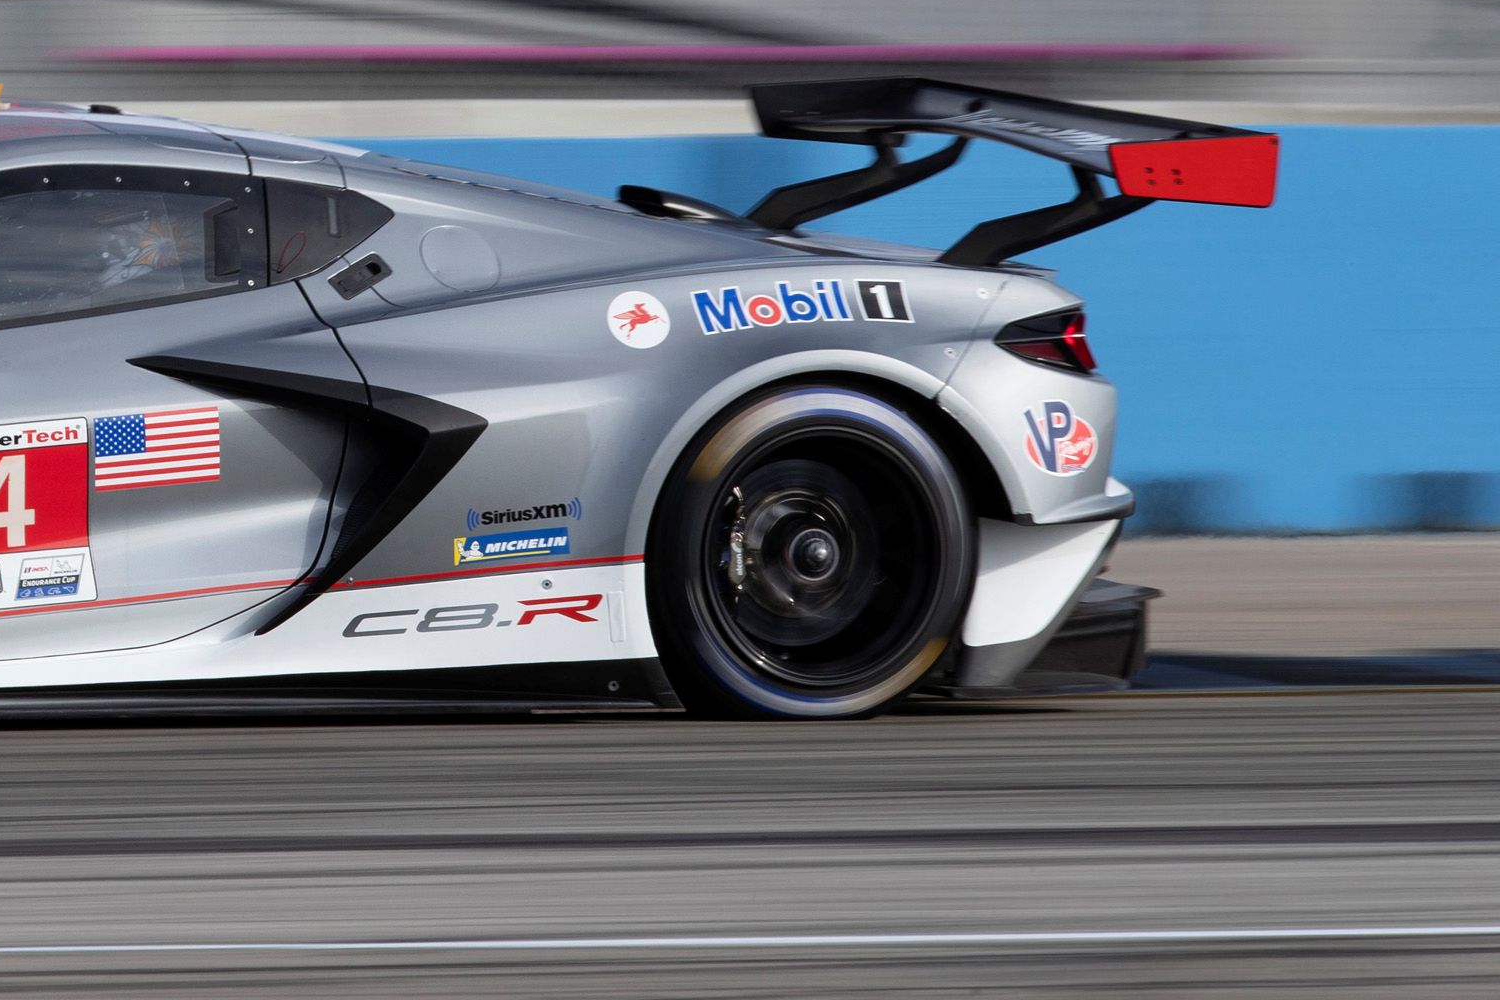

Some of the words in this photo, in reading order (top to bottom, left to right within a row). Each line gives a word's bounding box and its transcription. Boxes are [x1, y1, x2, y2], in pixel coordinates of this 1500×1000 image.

[693, 280, 852, 334] Mobil
[1023, 401, 1072, 473] VP
[484, 536, 568, 554] MICHELIN
[342, 593, 603, 638] C8.R
